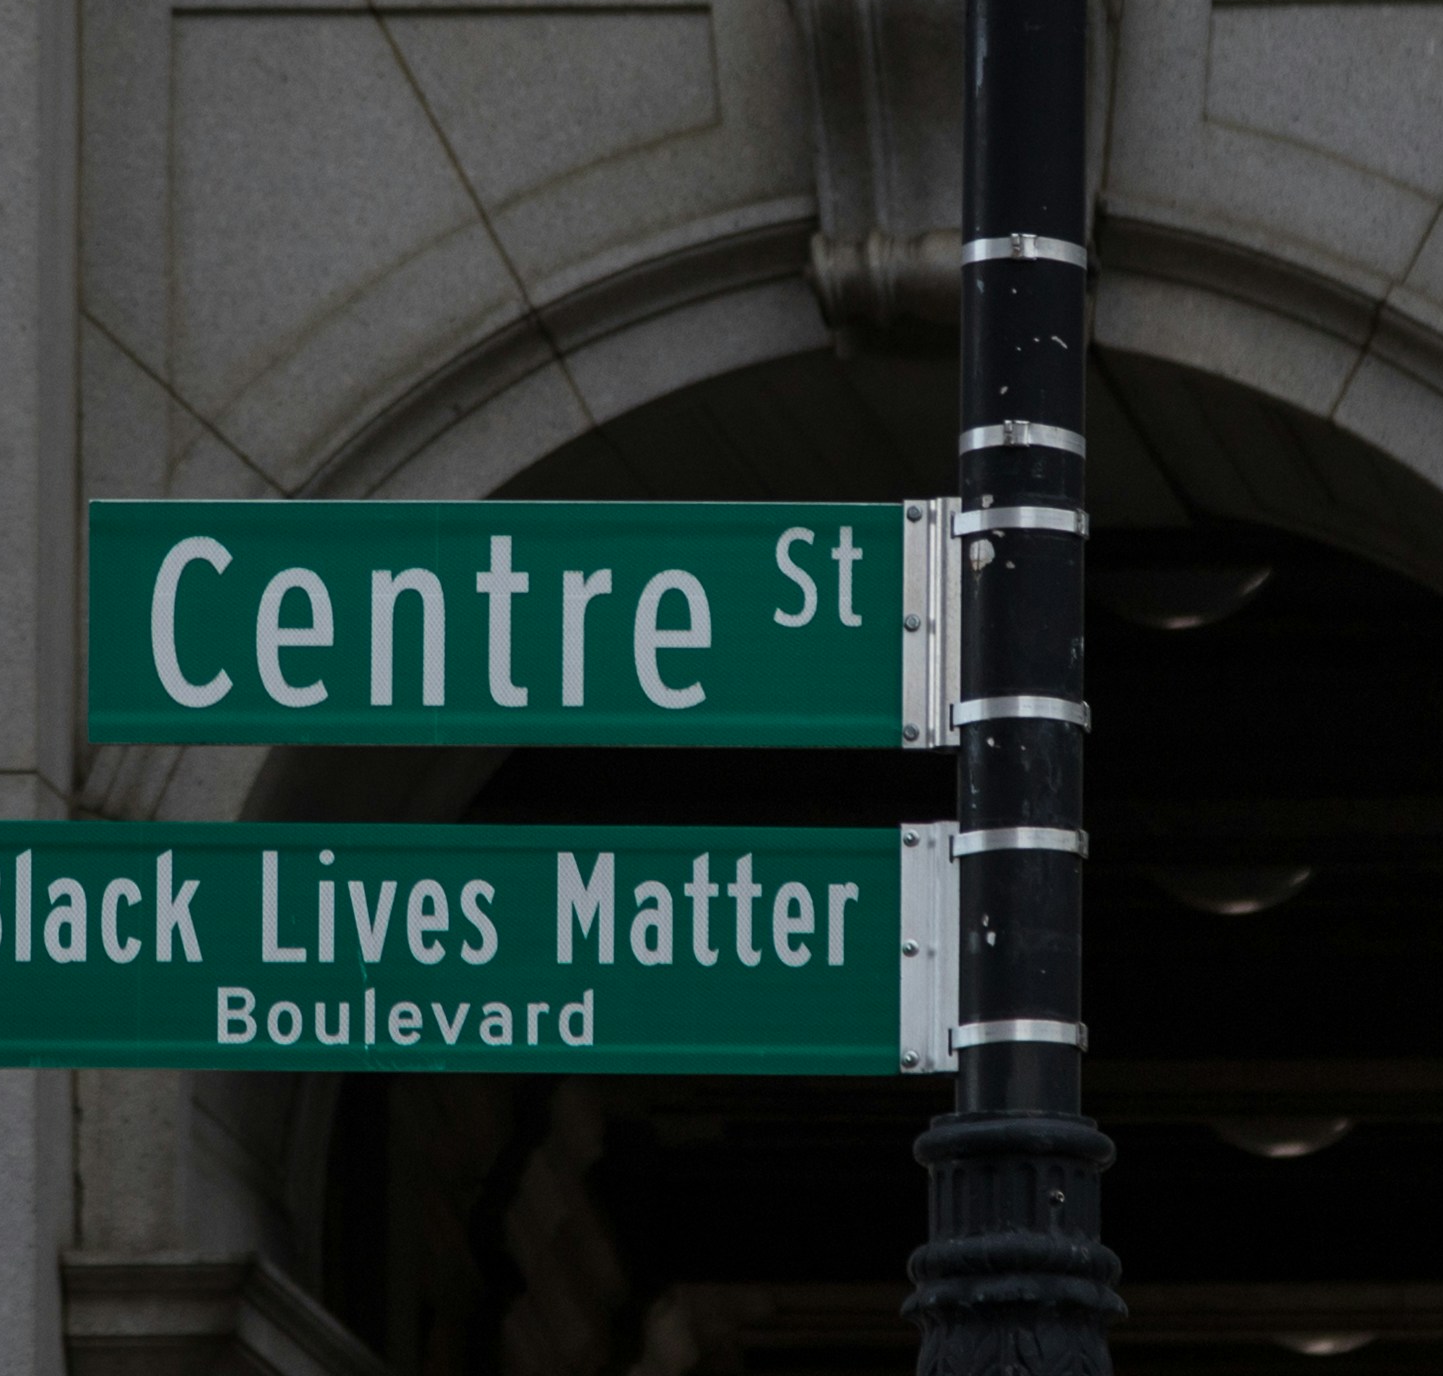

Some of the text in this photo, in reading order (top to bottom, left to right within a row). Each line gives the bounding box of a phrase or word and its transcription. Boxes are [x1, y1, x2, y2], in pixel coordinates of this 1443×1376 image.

[150, 526, 863, 709] Centre St
[261, 850, 498, 965] Lives
[556, 851, 859, 967] Matter
[217, 986, 594, 1046] Boulevard
